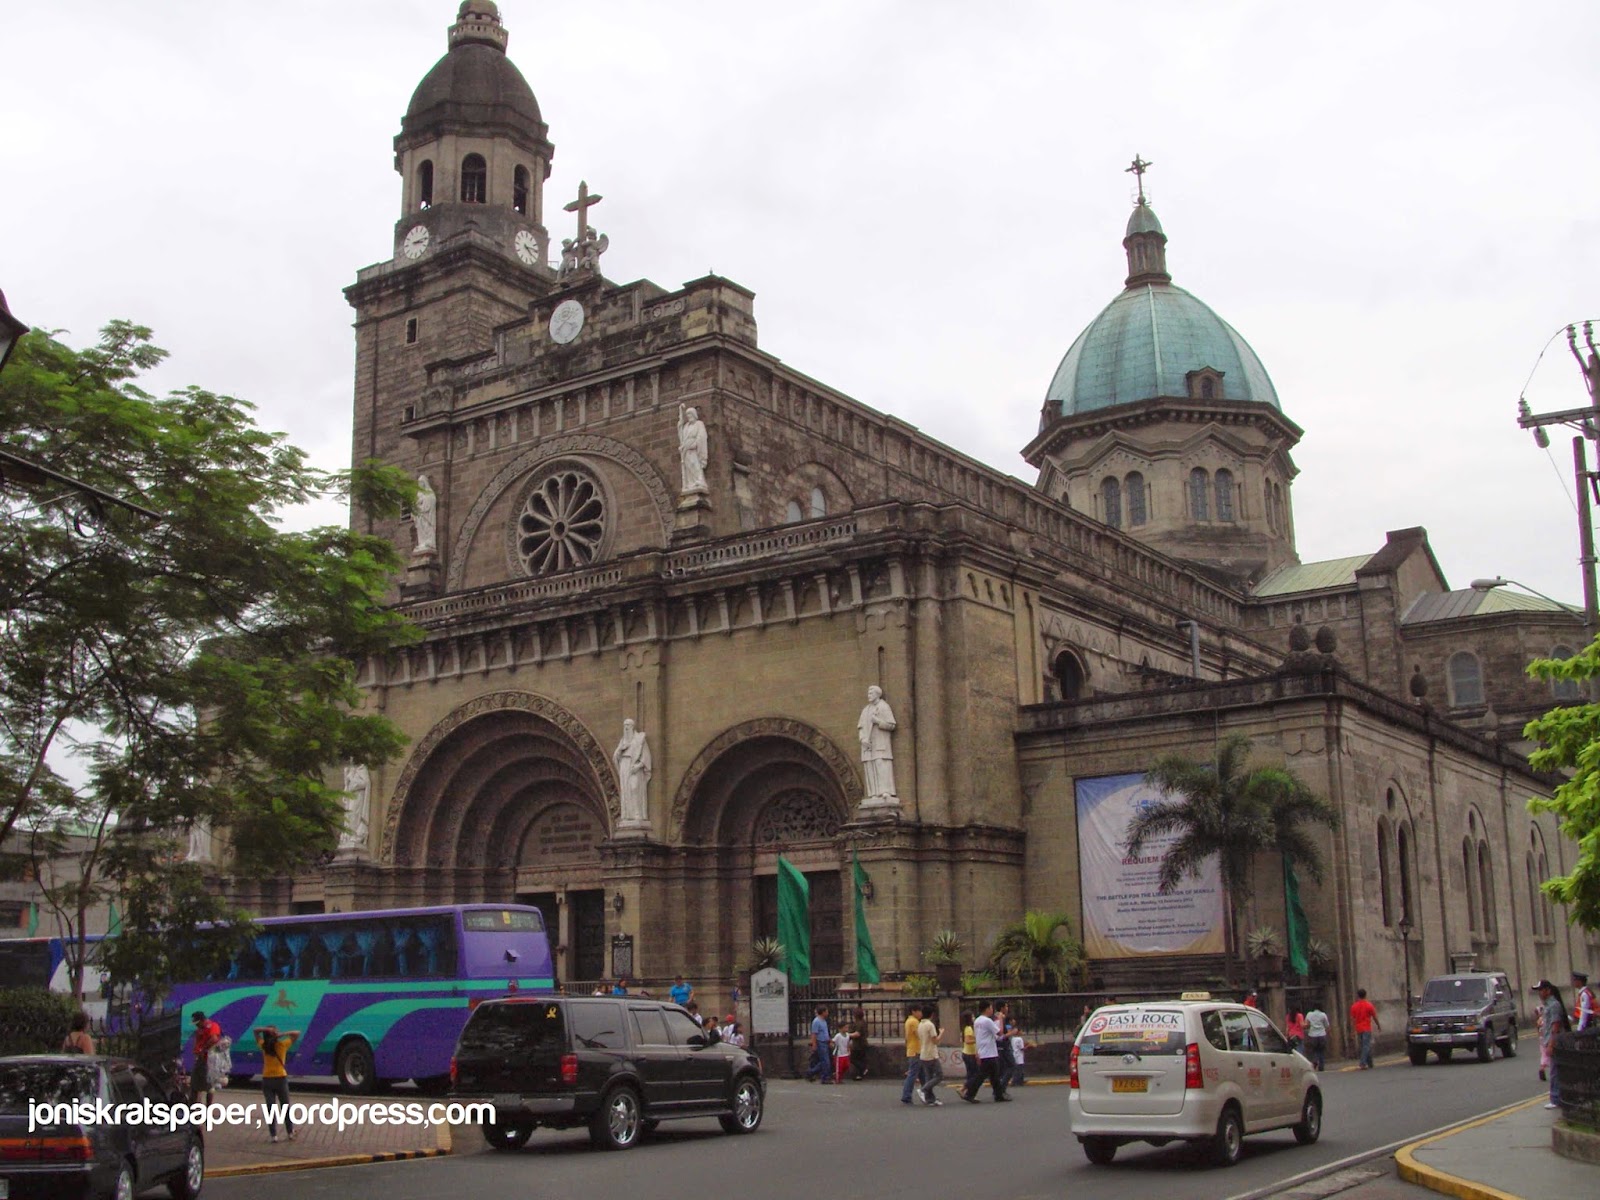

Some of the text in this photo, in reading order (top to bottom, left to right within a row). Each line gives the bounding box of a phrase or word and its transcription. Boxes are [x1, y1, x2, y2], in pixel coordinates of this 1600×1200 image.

[1121, 856, 1159, 865] REQUIEM
[1108, 1013, 1180, 1025] EASY ROCK
